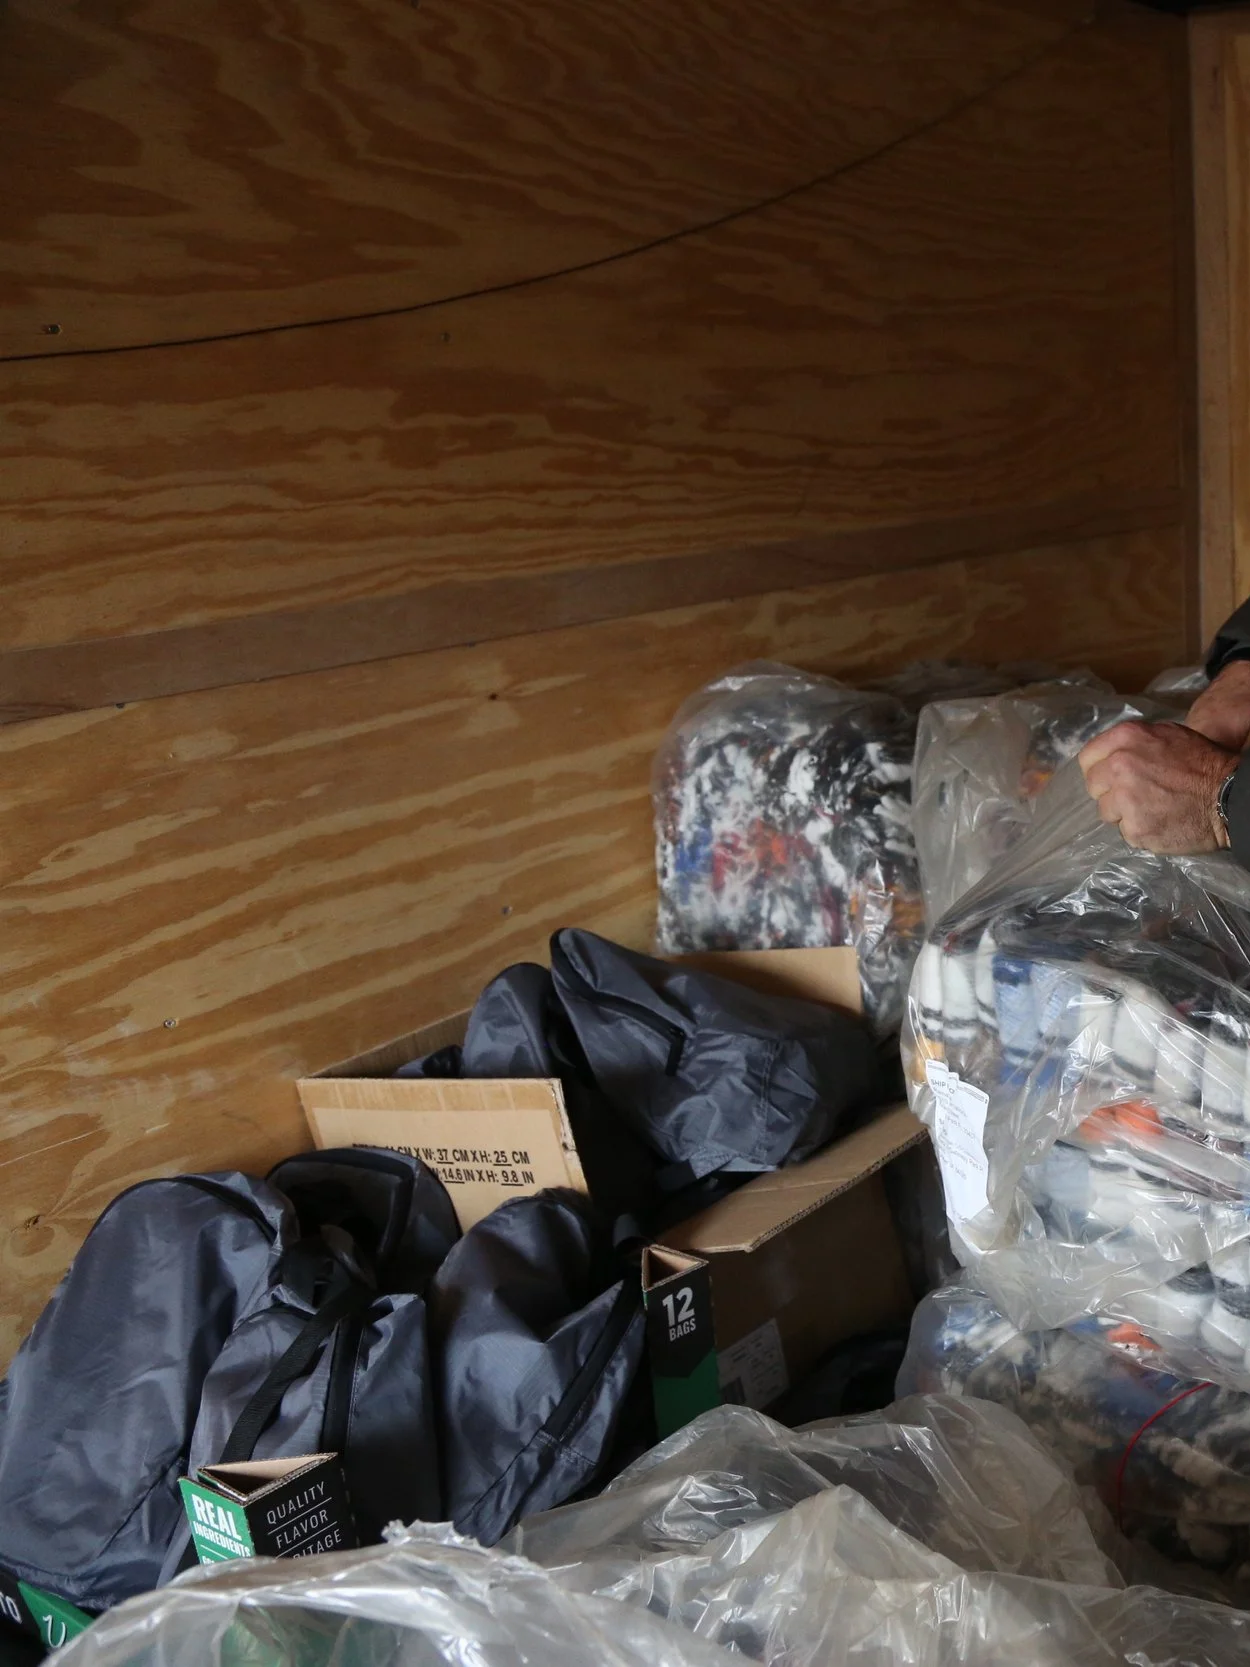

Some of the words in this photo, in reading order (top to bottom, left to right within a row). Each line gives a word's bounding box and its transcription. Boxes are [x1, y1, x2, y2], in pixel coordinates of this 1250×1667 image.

[930, 1078, 946, 1090] SHIP
[422, 1148, 437, 1161] W:
[437, 1149, 448, 1161] 37
[452, 1149, 470, 1162] CM
[470, 1150, 480, 1162] X
[480, 1150, 492, 1163] H:
[493, 1151, 508, 1163] 25
[511, 1151, 530, 1164] CM
[442, 1168, 463, 1180] 14.6
[464, 1169, 475, 1182] IN
[476, 1170, 486, 1182] X
[486, 1170, 499, 1183] H:
[501, 1171, 519, 1183] 9.8
[522, 1171, 535, 1184] IN
[662, 1287, 695, 1327] 12
[669, 1318, 696, 1342] BAGS
[192, 1494, 242, 1541] REAL
[266, 1481, 325, 1525] QUALITY
[193, 1520, 251, 1558] INGREDIENTS
[276, 1509, 329, 1549] FLAVOR
